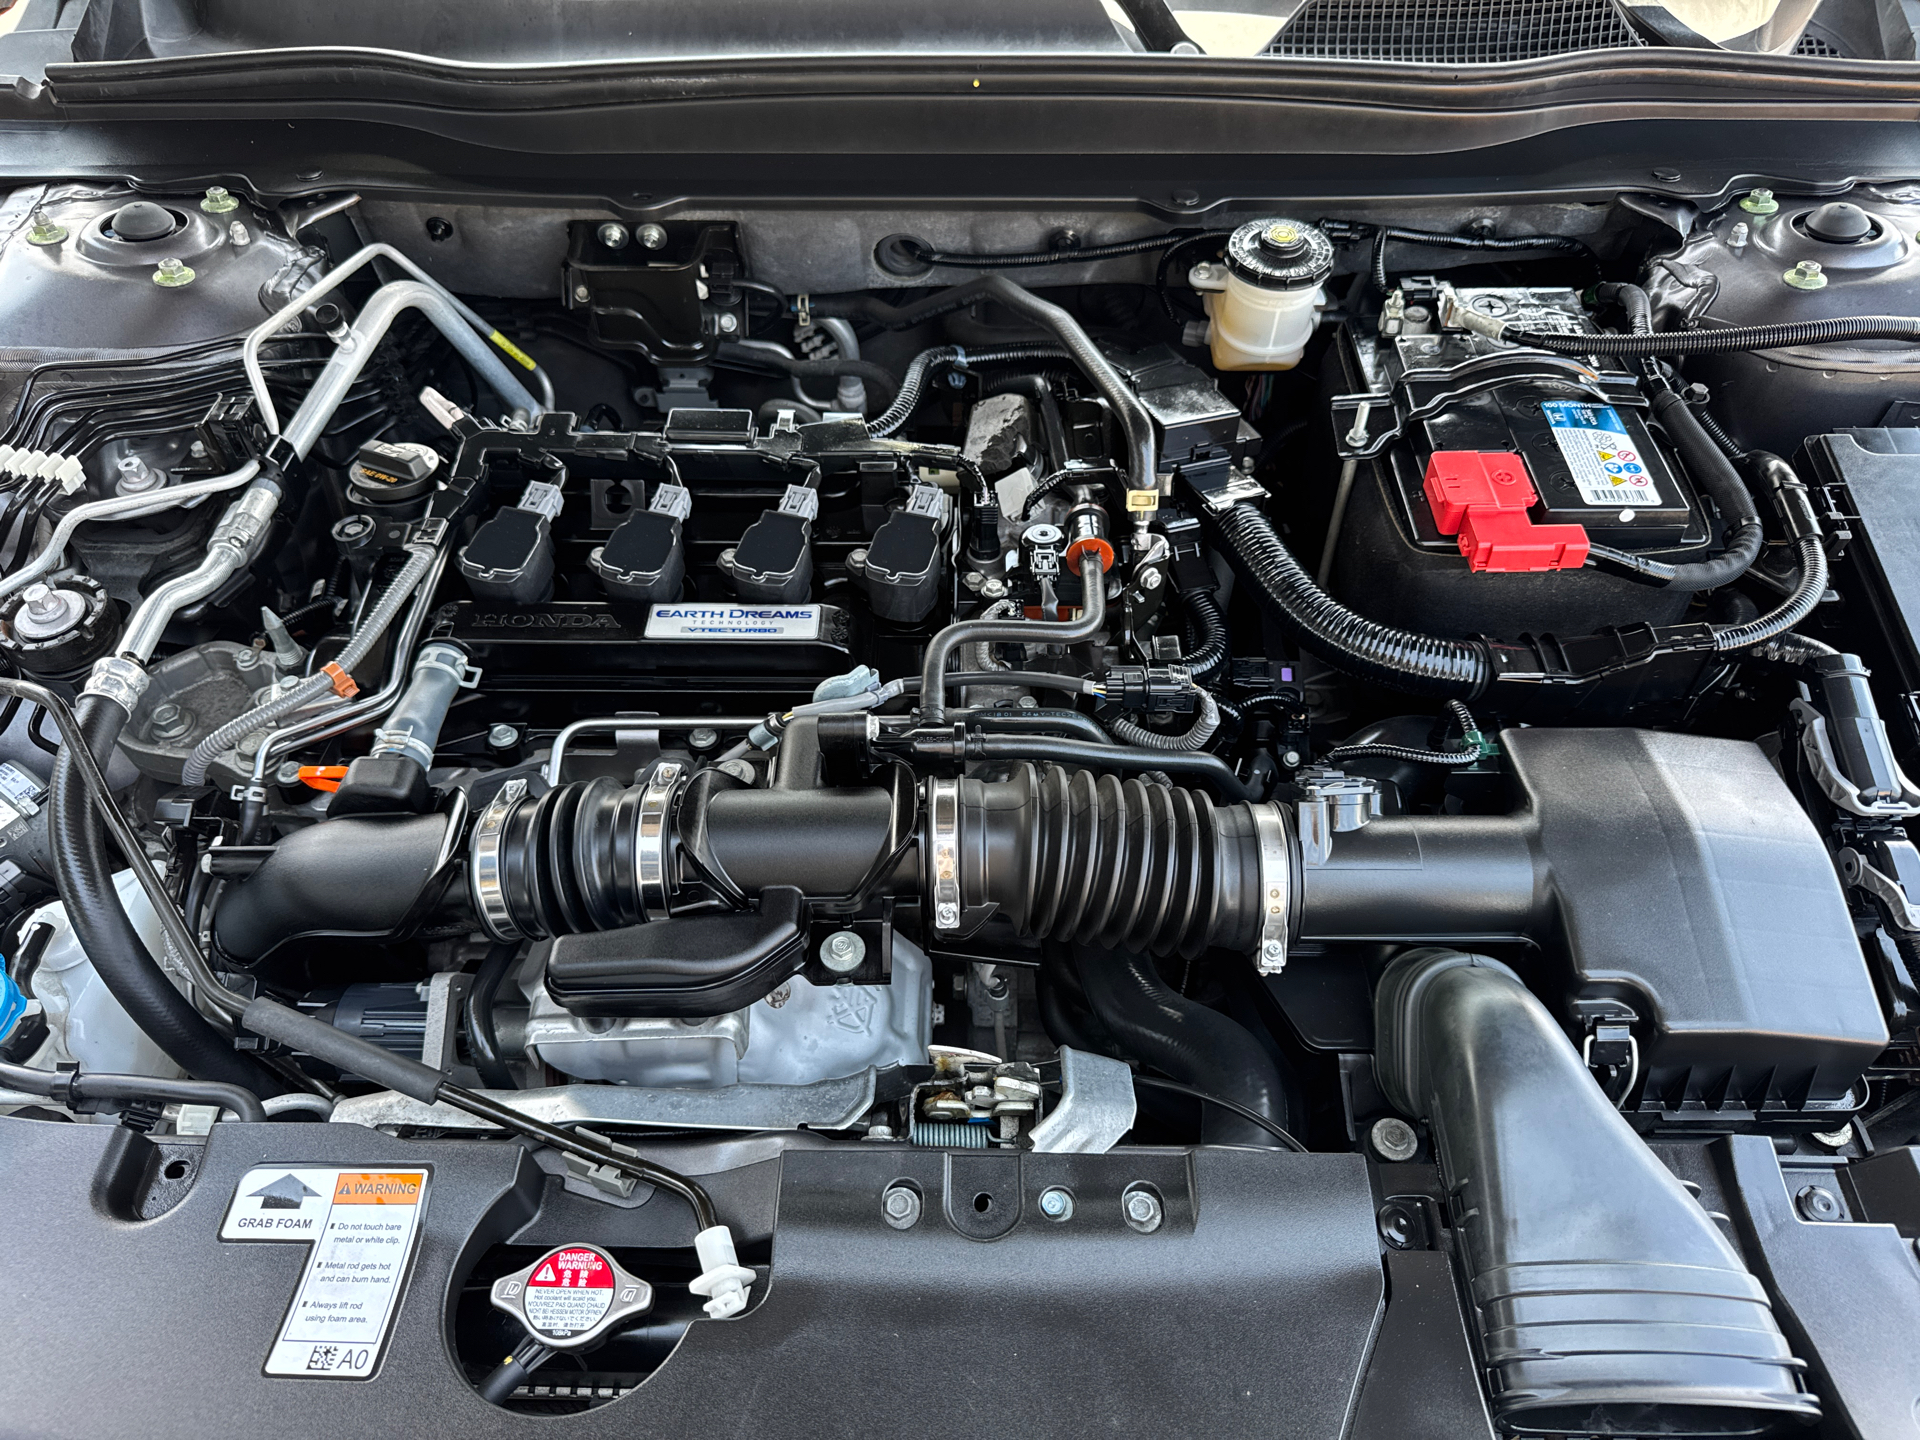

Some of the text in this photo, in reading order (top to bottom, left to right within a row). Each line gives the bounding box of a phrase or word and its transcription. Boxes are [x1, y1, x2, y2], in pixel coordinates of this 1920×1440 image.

[656, 609, 813, 619] EARTH DREAMS
[471, 613, 622, 629] HONDA
[354, 1183, 417, 1195] WARNING
[238, 1218, 313, 1229] GRAB FOAM
[350, 1223, 362, 1231] not
[363, 1223, 384, 1231] touch
[385, 1223, 402, 1231] bare
[365, 1236, 384, 1244] white
[385, 1236, 401, 1245] clip.
[559, 1253, 596, 1262] DANGER
[360, 1263, 377, 1271] gets
[558, 1261, 603, 1270] WARNUNG
[309, 1301, 337, 1310] Always
[338, 1301, 348, 1309] lift
[305, 1315, 326, 1324] using
[327, 1315, 347, 1323] foam
[336, 1349, 369, 1369] A0
